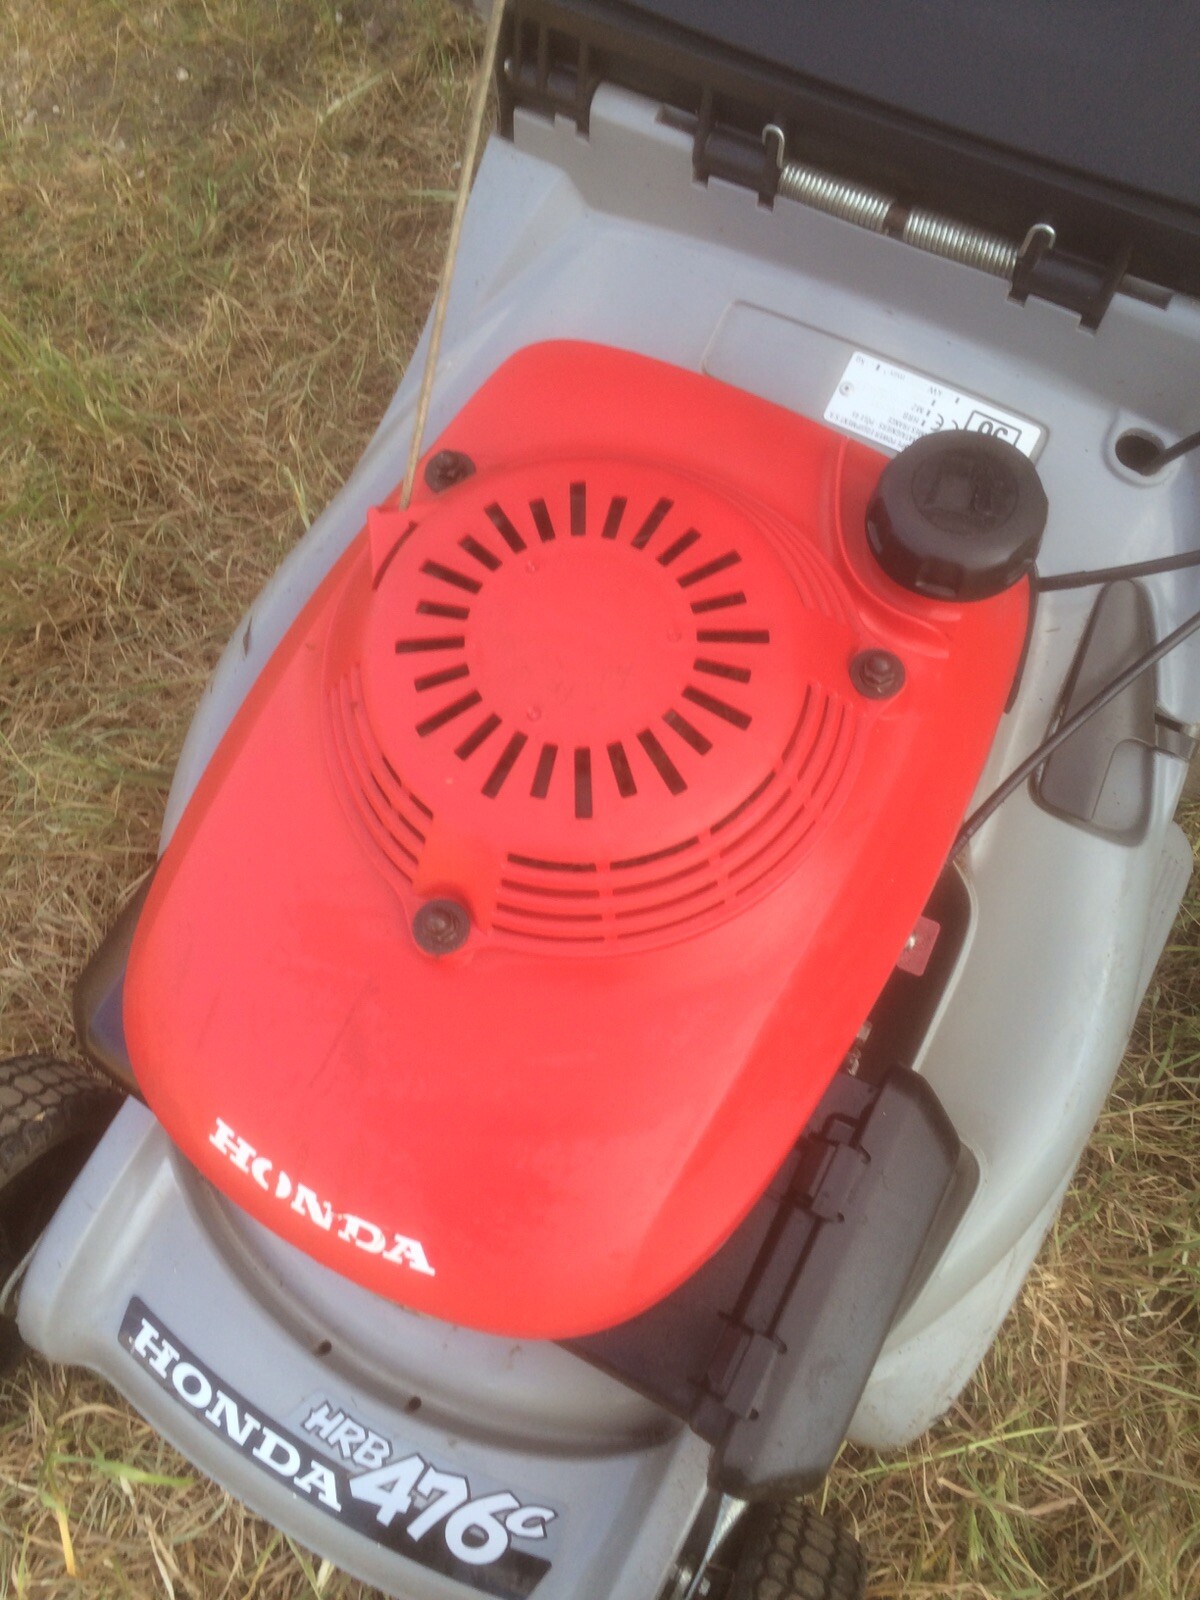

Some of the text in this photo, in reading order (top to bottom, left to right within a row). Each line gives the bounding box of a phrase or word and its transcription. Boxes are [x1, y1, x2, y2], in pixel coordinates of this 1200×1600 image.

[208, 1116, 436, 1277] HONDA
[129, 1317, 342, 1512] HONDA
[304, 1400, 393, 1469] HRB
